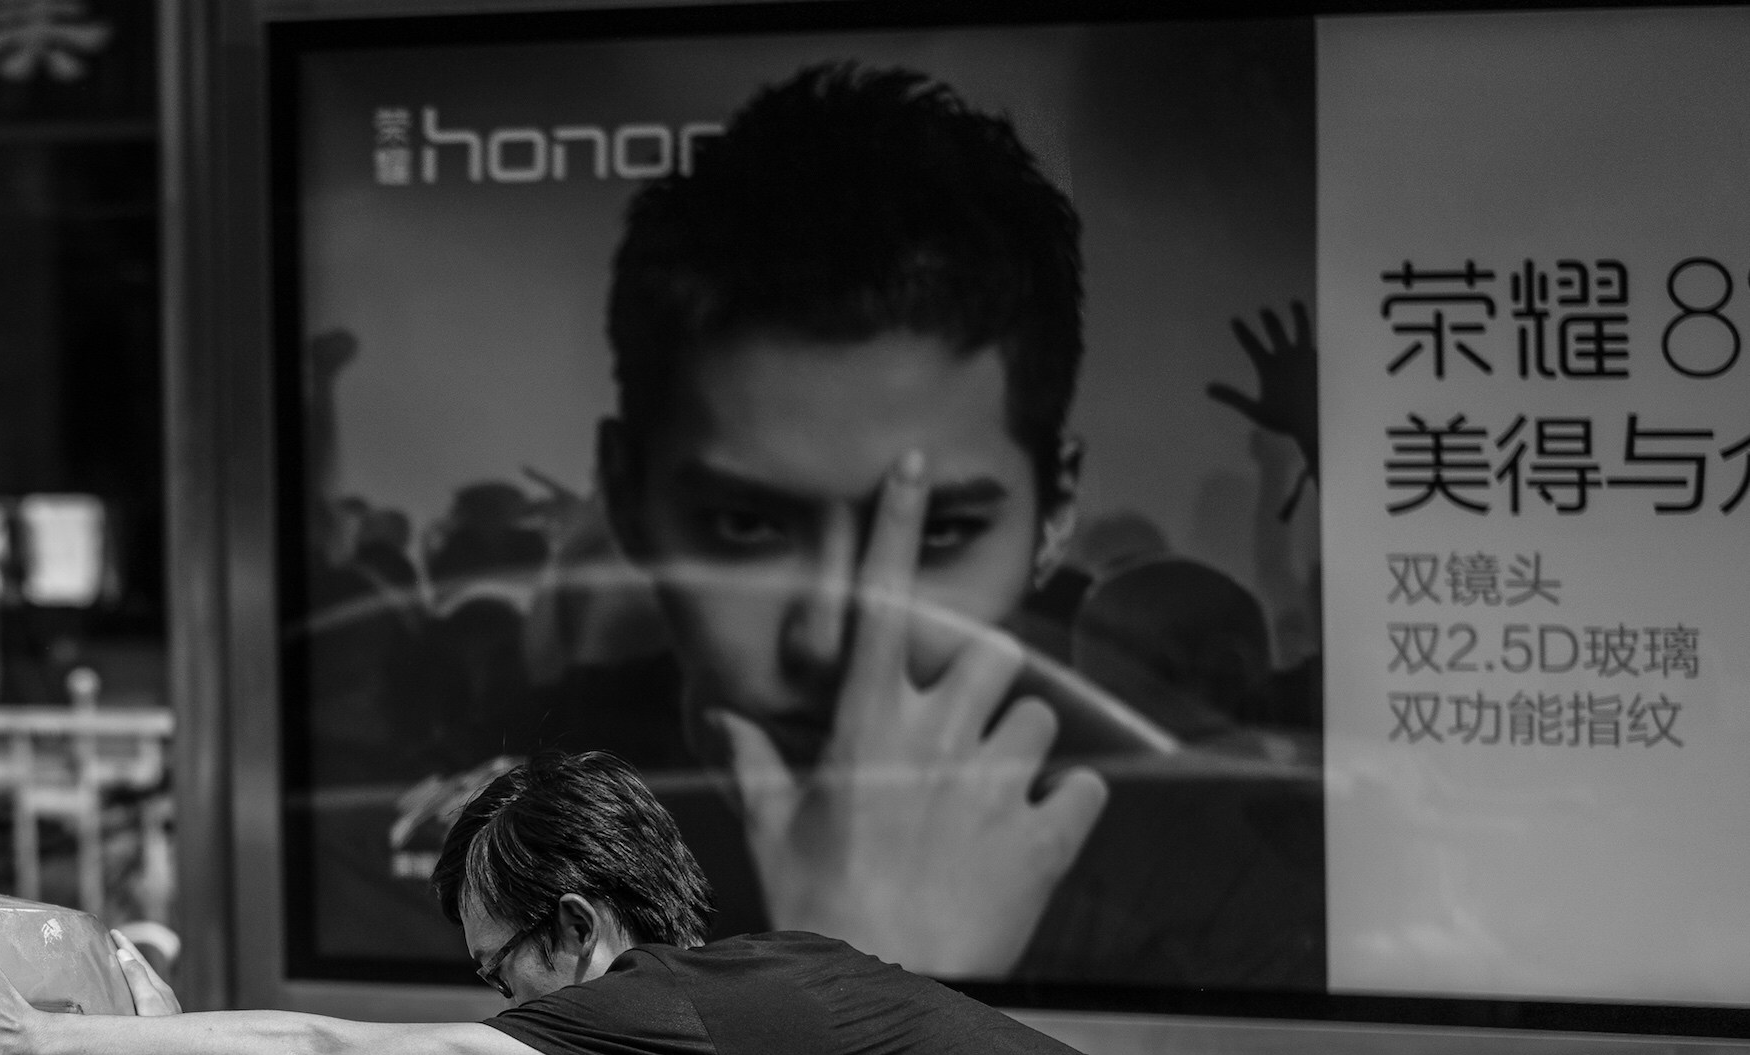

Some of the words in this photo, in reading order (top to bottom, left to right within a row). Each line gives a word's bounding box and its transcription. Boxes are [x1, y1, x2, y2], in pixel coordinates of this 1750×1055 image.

[421, 106, 728, 184] honor
[1386, 551, 1562, 607] 双镜头
[1387, 621, 1701, 680] 双2.5D玻璃
[1387, 690, 1684, 749] 双功能指纹
